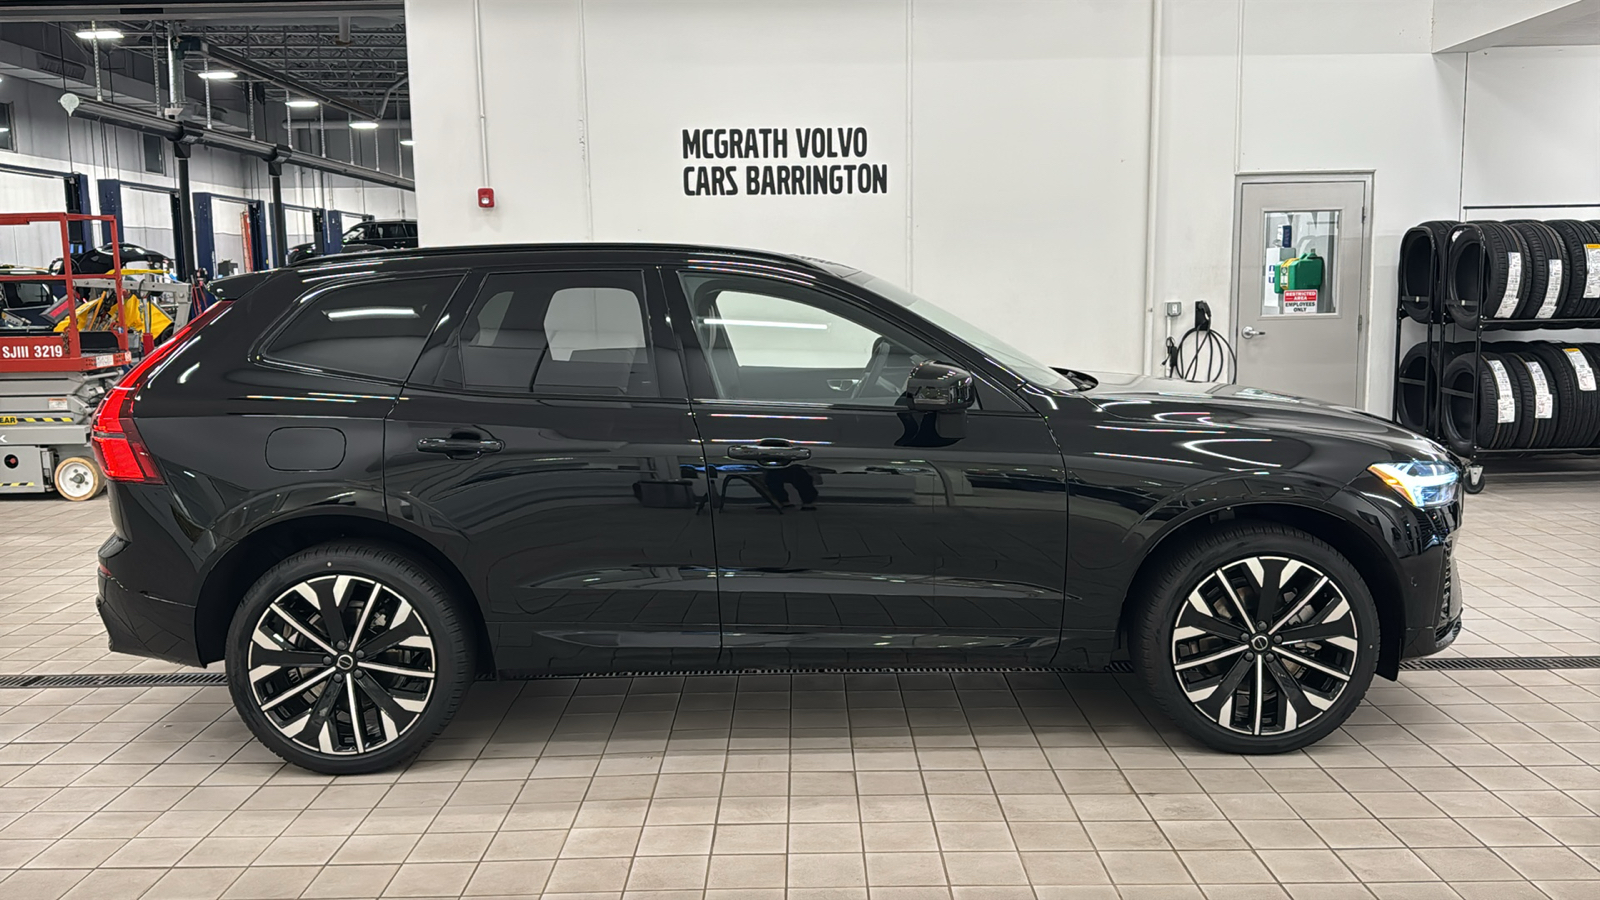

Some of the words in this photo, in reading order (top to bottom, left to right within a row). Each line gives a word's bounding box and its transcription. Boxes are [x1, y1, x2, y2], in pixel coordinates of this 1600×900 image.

[682, 128, 788, 159] MCGRATH
[795, 127, 868, 158] VOLVO
[683, 165, 739, 196] CARS
[746, 163, 888, 195] BARRINGTON
[2, 346, 29, 358] SJIII
[34, 345, 62, 358] 3219
